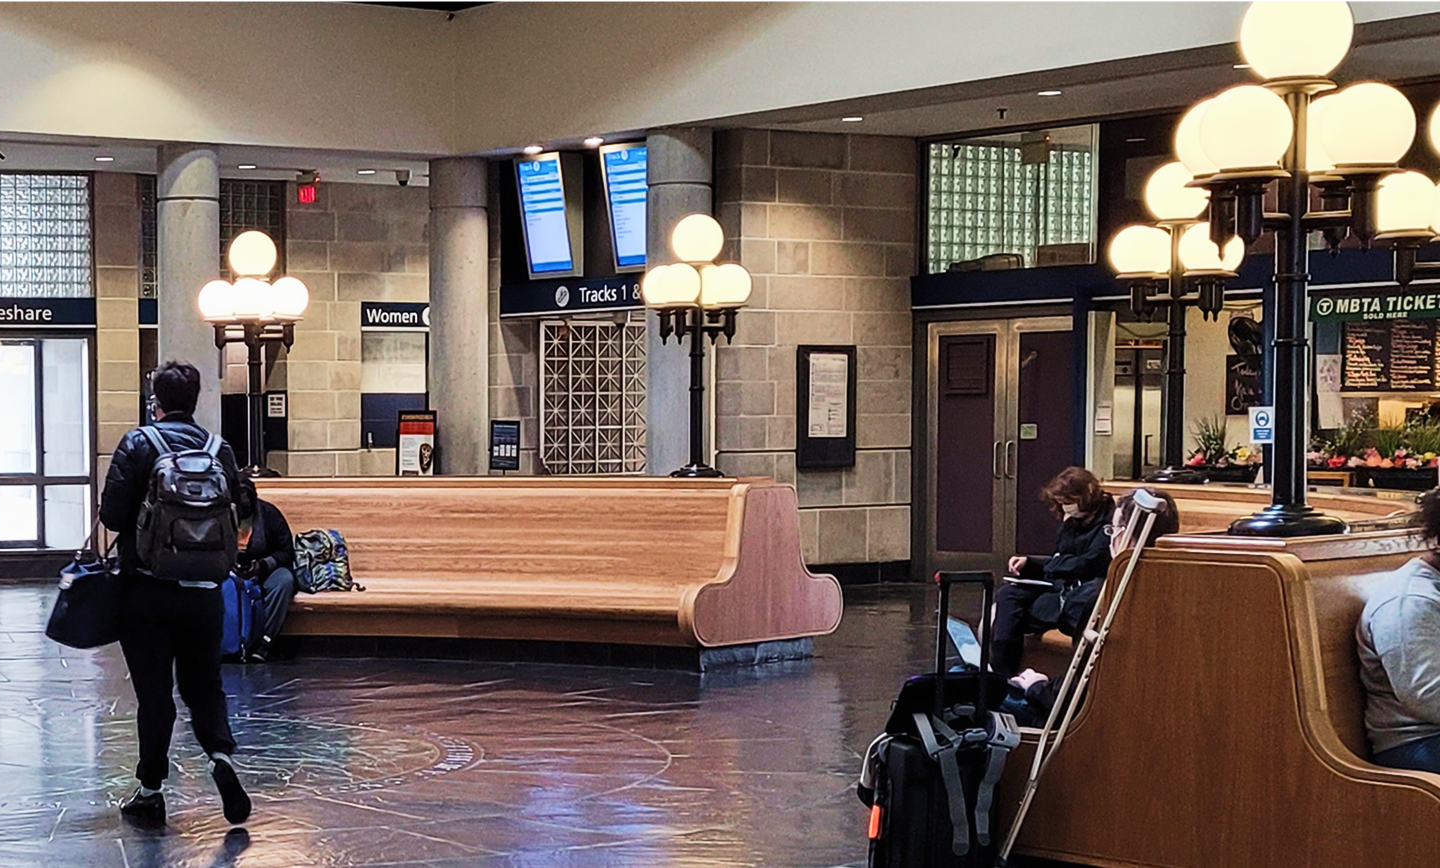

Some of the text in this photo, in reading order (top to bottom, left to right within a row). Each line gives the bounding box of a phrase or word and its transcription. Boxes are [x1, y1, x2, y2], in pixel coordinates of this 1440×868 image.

[578, 283, 642, 303] Tracks 1 &
[1335, 298, 1381, 314] MBTA
[365, 308, 418, 324] Women
[1386, 311, 1408, 319] HERE
